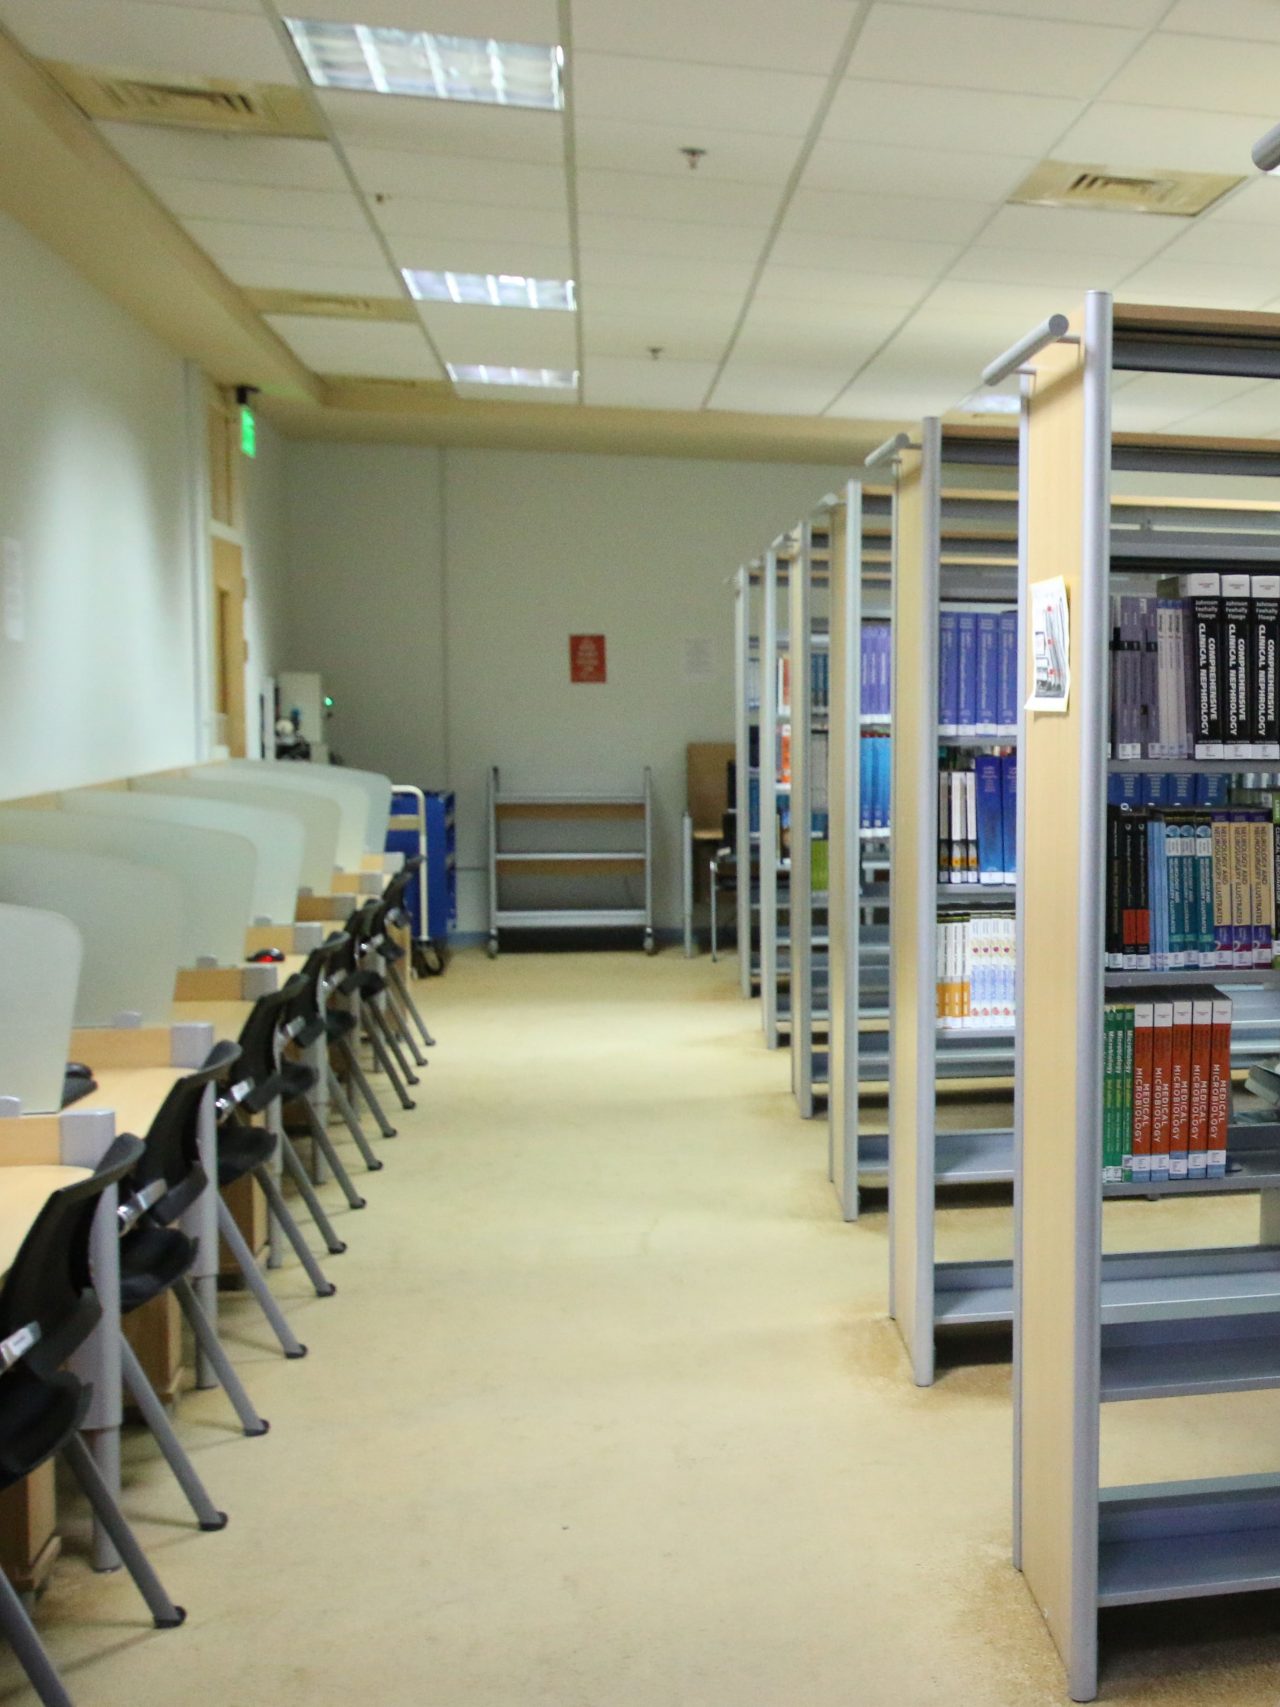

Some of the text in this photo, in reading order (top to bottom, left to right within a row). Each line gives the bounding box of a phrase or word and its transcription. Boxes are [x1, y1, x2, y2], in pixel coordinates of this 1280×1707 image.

[1134, 1068, 1143, 1142] MICROBIOLOGY
[1154, 1067, 1162, 1142] MICROBIOLOGY
[1172, 1065, 1181, 1139] MICROBIOLOGY
[1180, 1081, 1188, 1124] MEDICAL
[1192, 1064, 1200, 1139] MICROBIOLOGY
[1200, 1081, 1208, 1123] MEDICAL
[1210, 1064, 1220, 1138] MICROBIOLOGY
